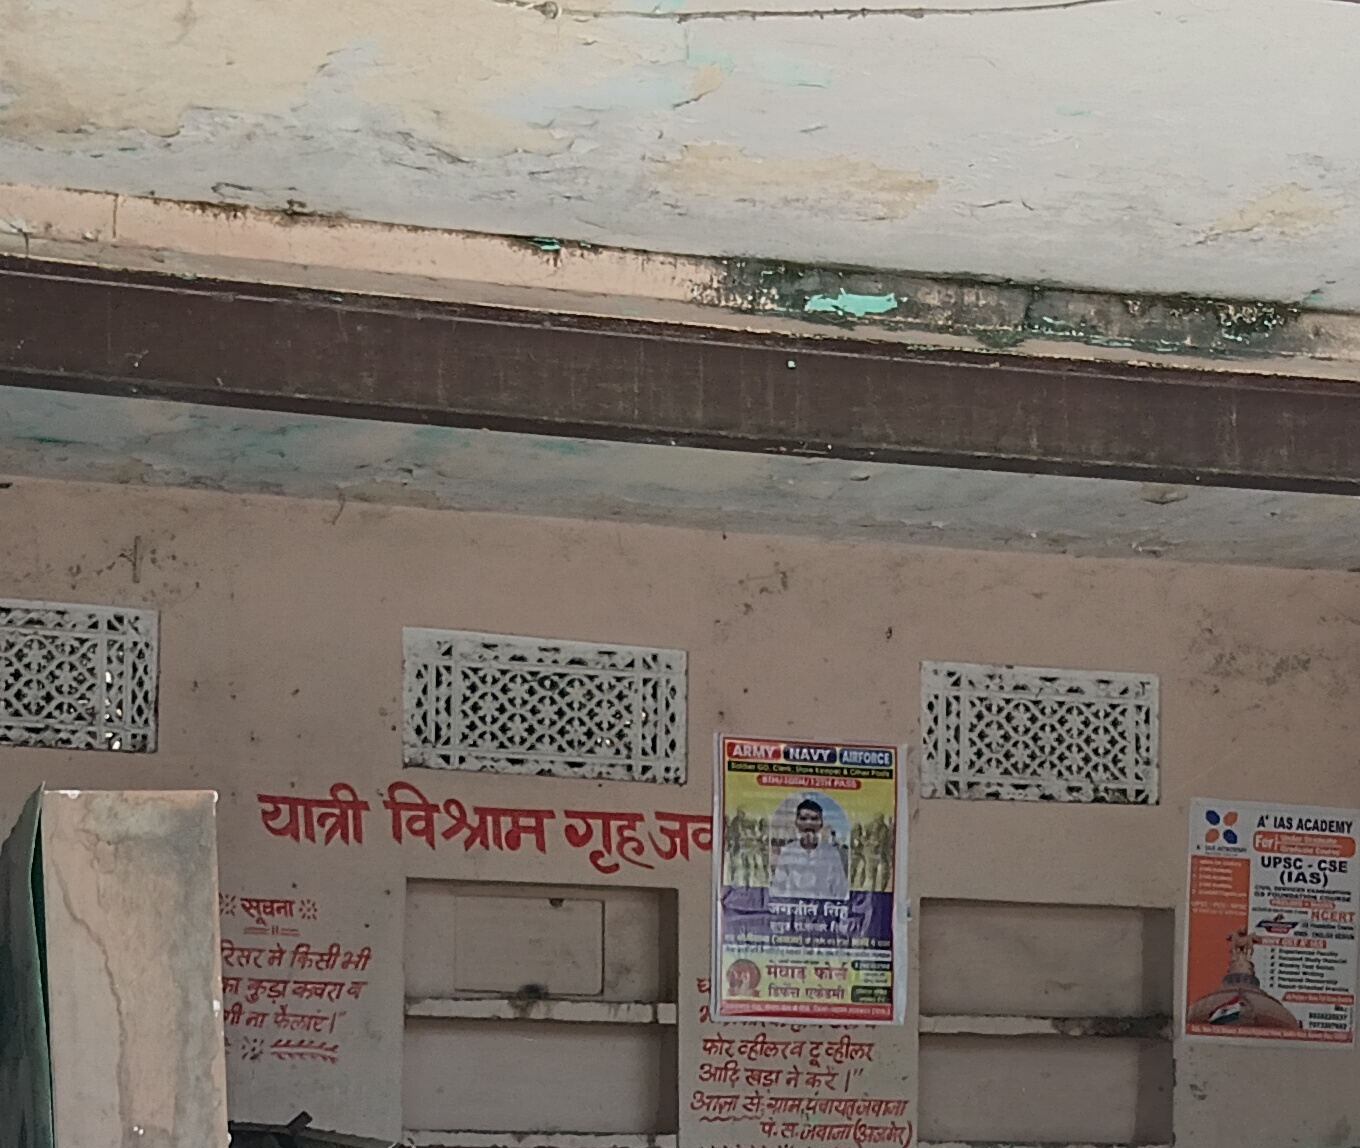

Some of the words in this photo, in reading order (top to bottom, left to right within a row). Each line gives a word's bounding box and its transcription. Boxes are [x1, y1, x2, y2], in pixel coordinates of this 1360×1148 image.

[732, 744, 777, 759] ARMY
[789, 746, 831, 763] NAVY
[841, 749, 891, 766] AIRFORCE
[833, 778, 858, 789] PASS
[257, 781, 370, 848] यात्री
[383, 780, 557, 855] विश्राम
[564, 807, 655, 874] गृह
[1273, 816, 1293, 831] IAS
[1296, 817, 1353, 834] ACADEMY
[1255, 833, 1274, 849] For
[1261, 855, 1304, 870] UPSC
[1317, 859, 1348, 874] CSE
[1279, 869, 1329, 888] (IAS)
[1311, 908, 1356, 924] NCERT
[290, 942, 341, 972] किसी
[340, 946, 372, 972] भी
[347, 980, 369, 1000] व
[245, 1011, 270, 1029] ना
[703, 1031, 735, 1059] फोर
[808, 1041, 825, 1069] टू
[825, 1034, 875, 1064] व्हीलर
[698, 1059, 741, 1089] आदि
